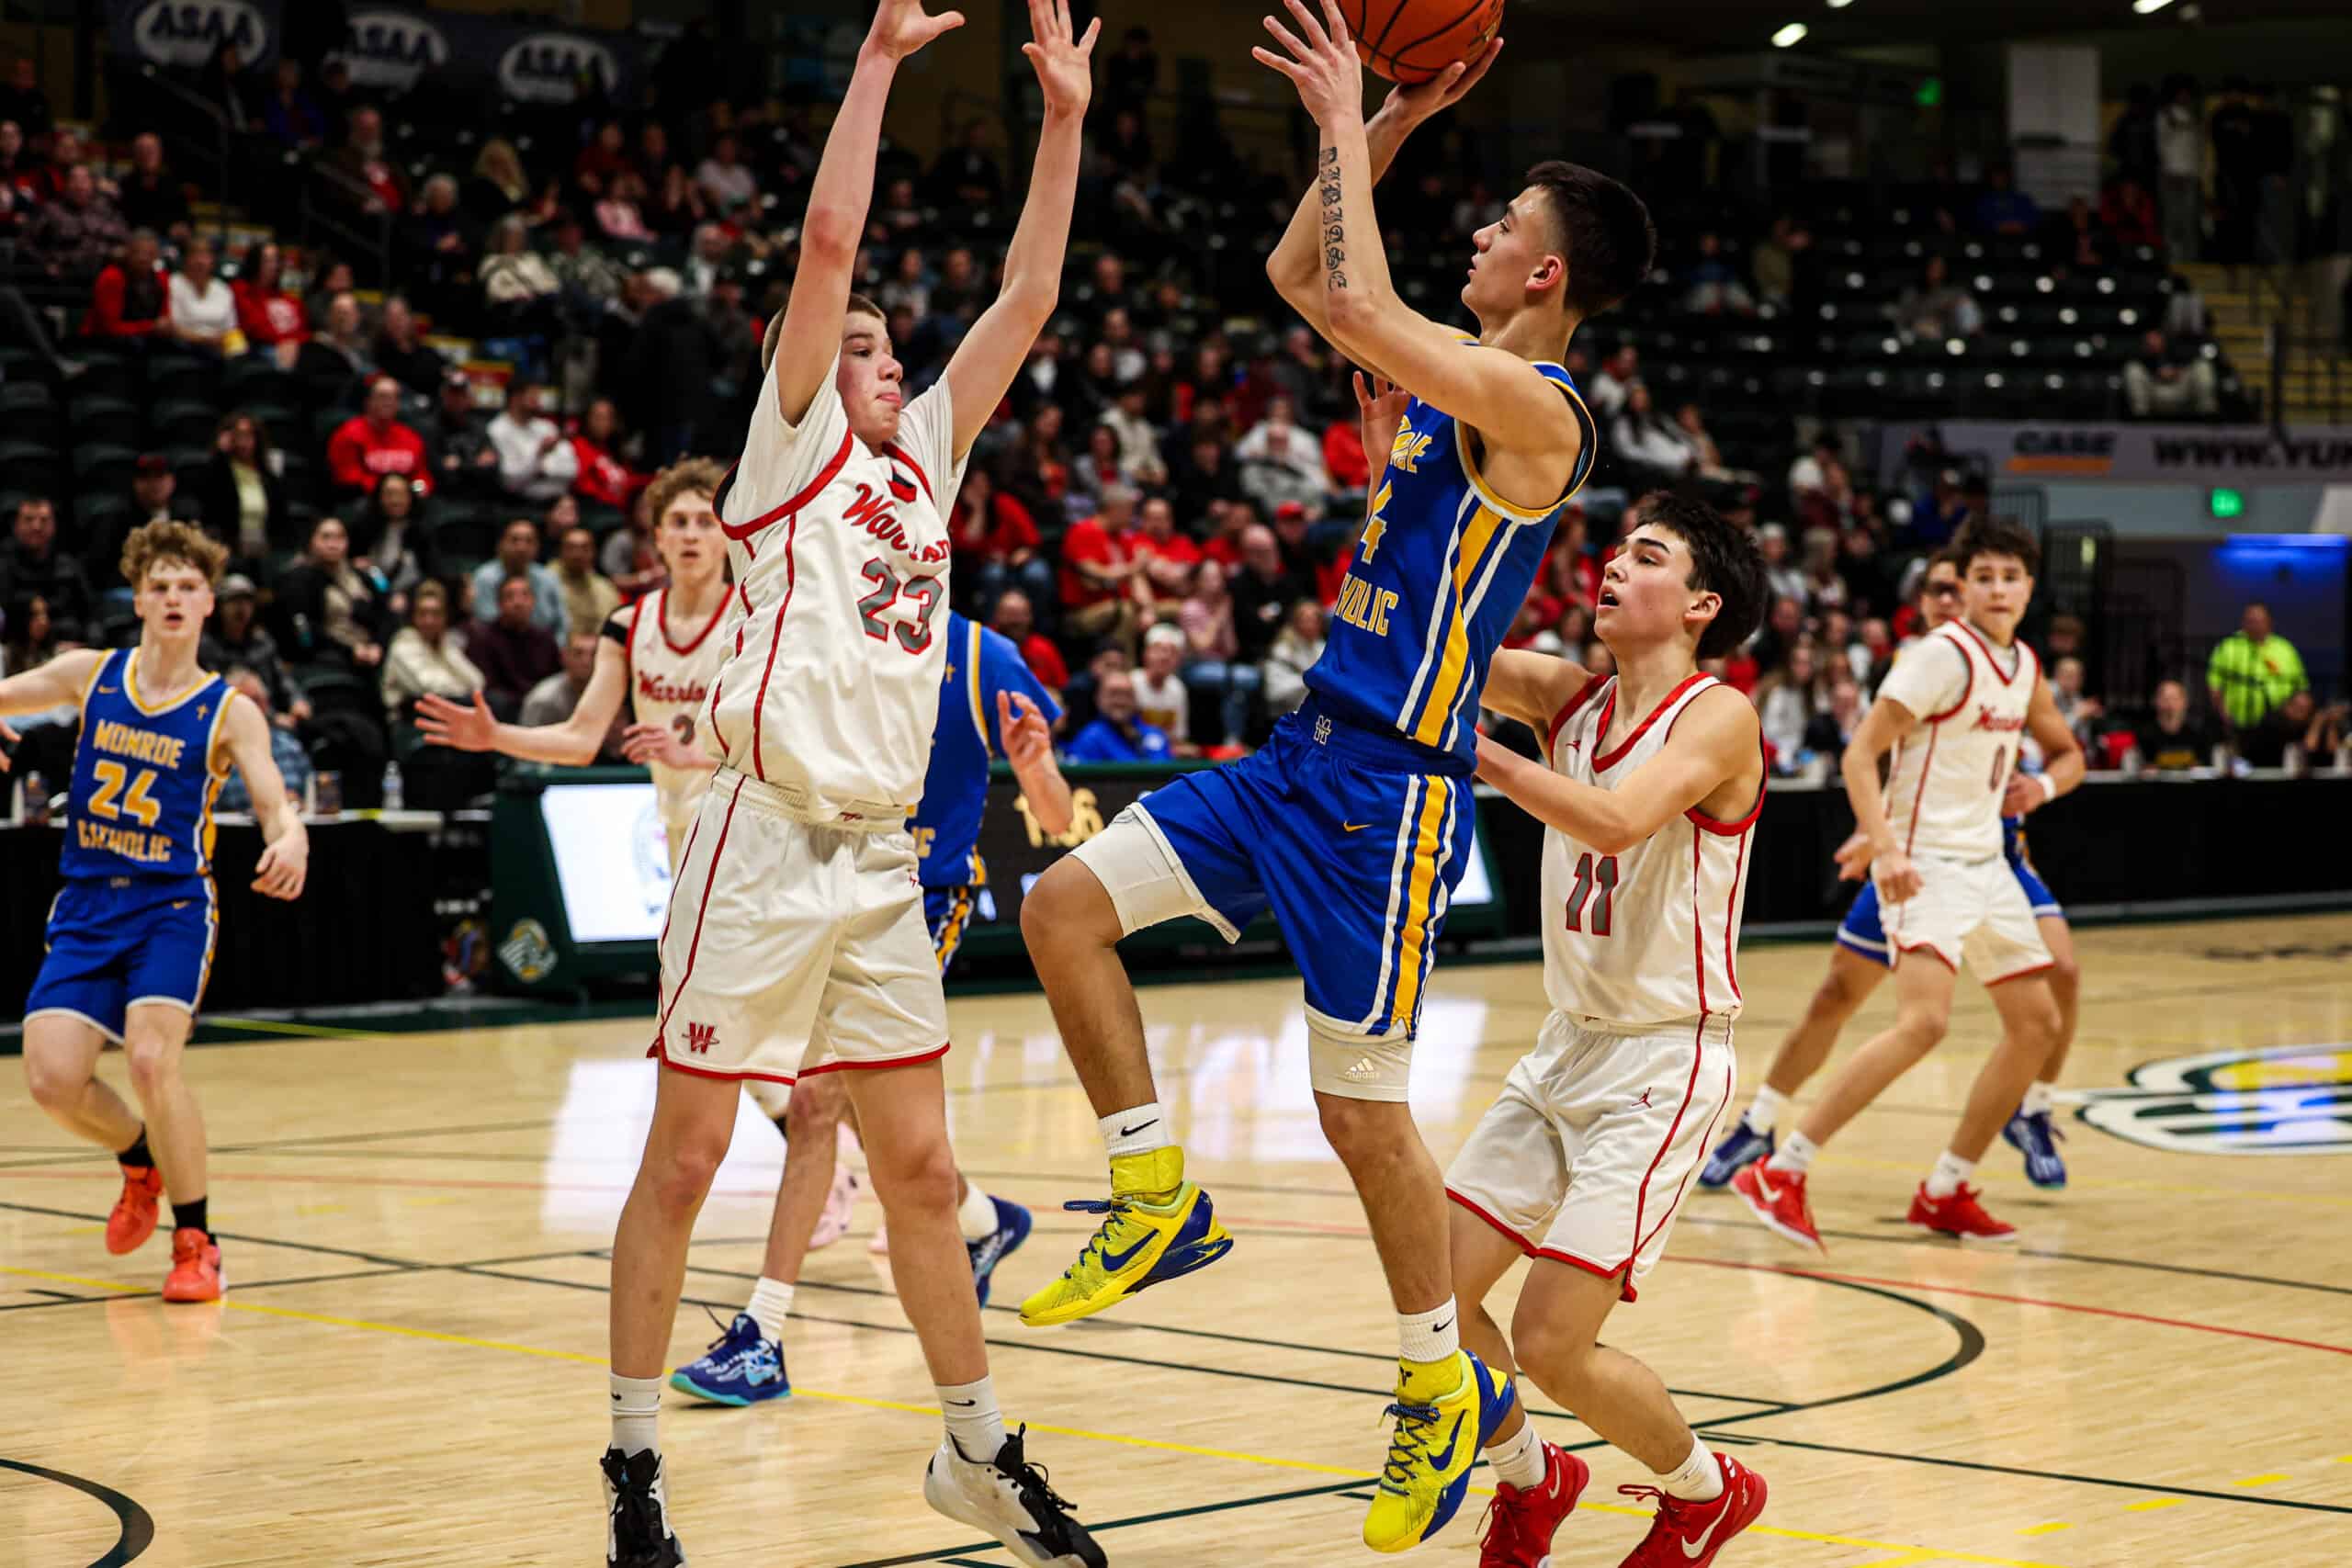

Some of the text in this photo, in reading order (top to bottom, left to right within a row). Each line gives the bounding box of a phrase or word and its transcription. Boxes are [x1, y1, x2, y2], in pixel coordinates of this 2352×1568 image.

[857, 557, 944, 655] 23
[638, 670, 706, 703] Warrio
[93, 718, 186, 770] MONROE
[88, 759, 162, 827] 24
[77, 819, 173, 863] CATHOLIC
[1566, 852, 1619, 937] 11
